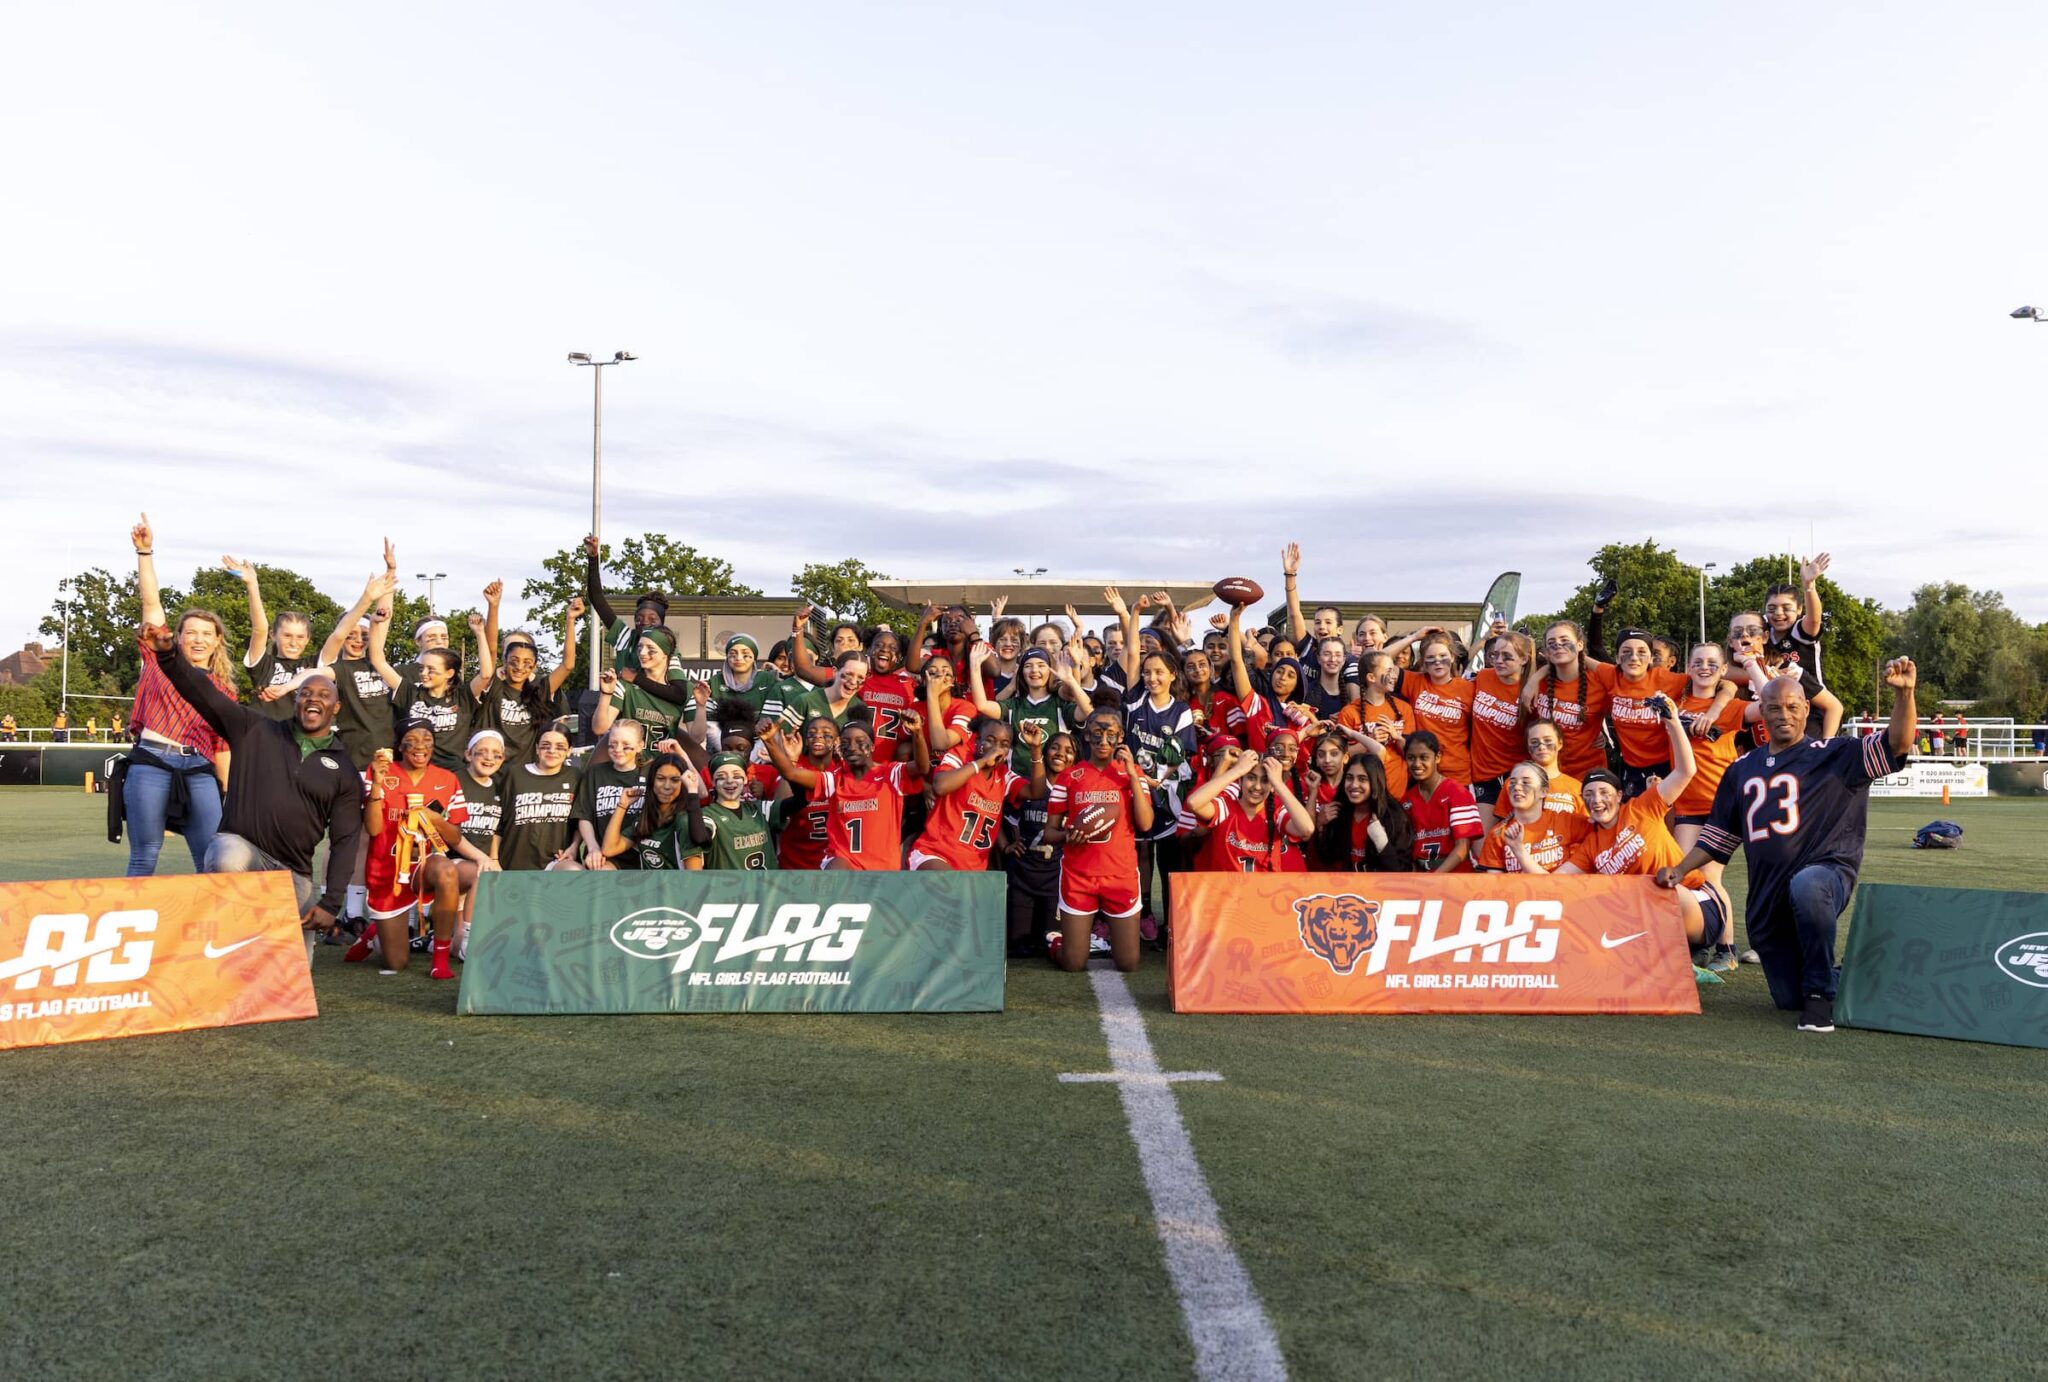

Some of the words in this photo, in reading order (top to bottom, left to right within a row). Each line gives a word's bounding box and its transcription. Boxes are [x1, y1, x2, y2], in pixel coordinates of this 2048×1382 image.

[1414, 700, 1463, 720] CHAMPIONS
[515, 792, 543, 807] 2023
[515, 803, 573, 820] CHAMPIONS
[1743, 773, 1801, 843] 23
[845, 817, 863, 854] 1
[959, 810, 997, 849] 15
[622, 927, 693, 940] JETS
[671, 903, 872, 974] FLAG
[1366, 900, 1563, 976] FLAG
[688, 972, 712, 985] NFL
[715, 972, 752, 986] GIRLS
[753, 972, 787, 985] FLAG
[788, 972, 851, 985] FOOTBALL
[1386, 974, 1410, 988] NFL
[1413, 974, 1452, 988] GIRLS
[1454, 974, 1489, 988] FLAG
[1491, 974, 1559, 989] FOOTBALL
[16, 1000, 62, 1021] FLAG
[65, 991, 153, 1015] FOOTBALL
